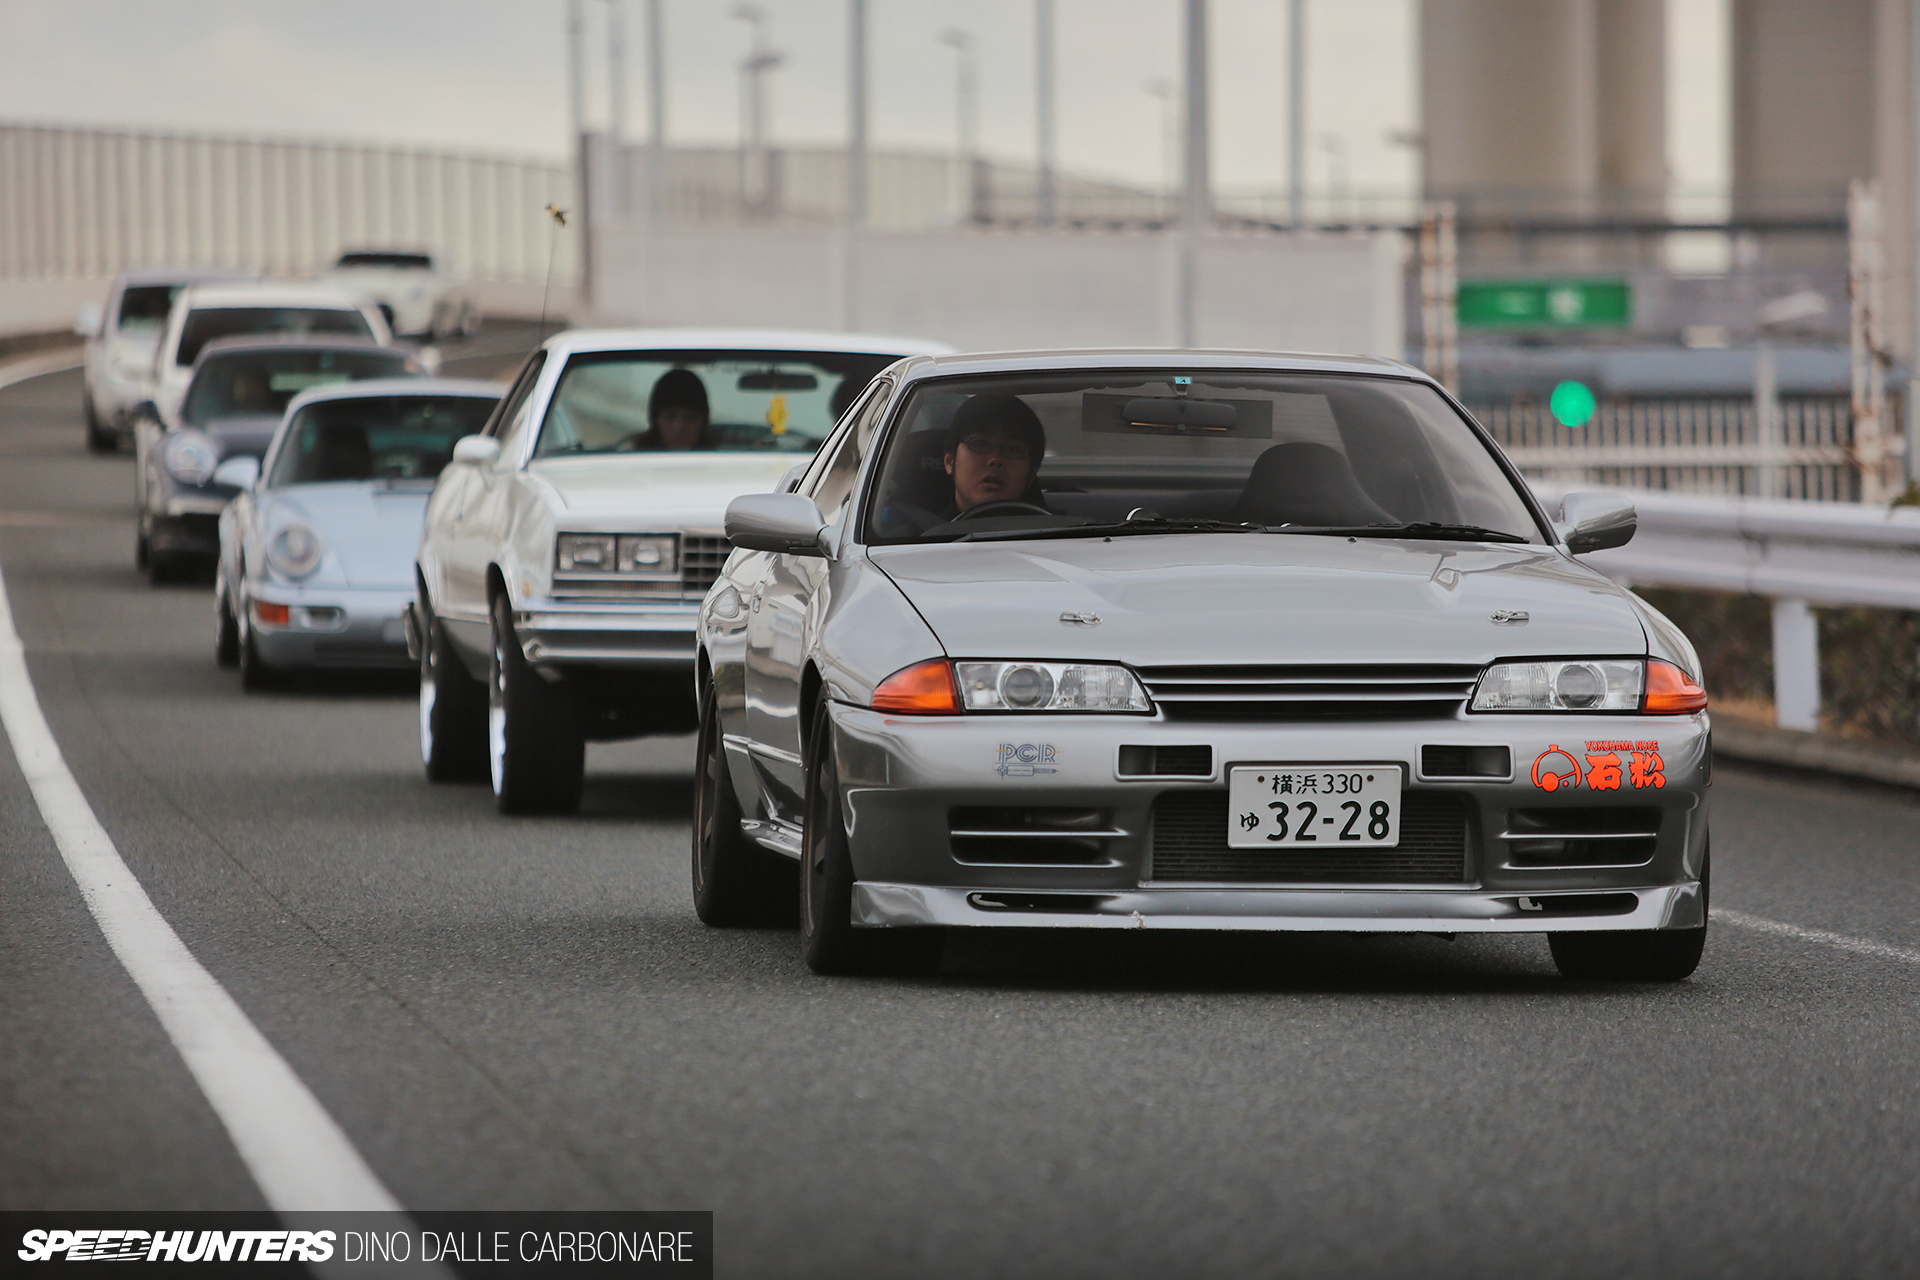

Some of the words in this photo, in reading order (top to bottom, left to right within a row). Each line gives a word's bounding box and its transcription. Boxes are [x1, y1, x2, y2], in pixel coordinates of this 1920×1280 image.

[998, 743, 1056, 763] PCR
[1585, 740, 1635, 752] YOKOHAMA
[1635, 740, 1659, 752] NOGE
[1585, 752, 1666, 791] 石松
[1239, 811, 1260, 832] ゆ
[1266, 800, 1390, 841] 32-28
